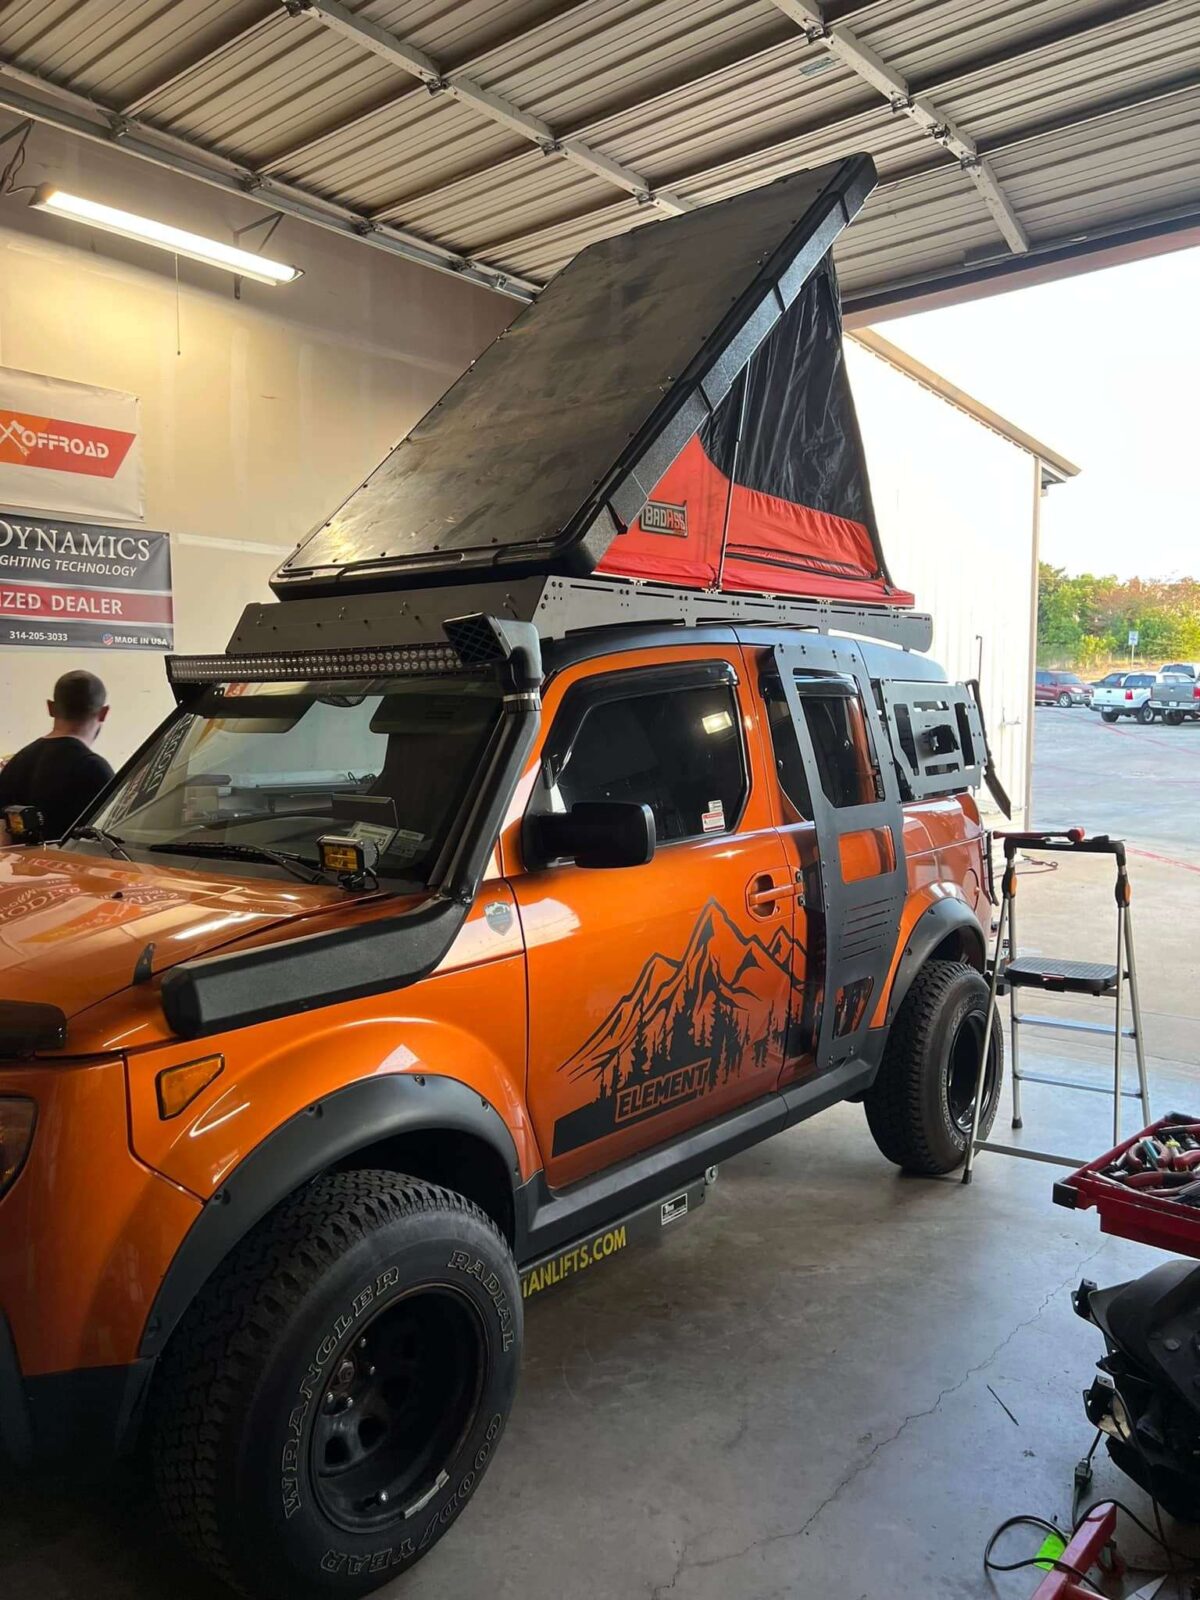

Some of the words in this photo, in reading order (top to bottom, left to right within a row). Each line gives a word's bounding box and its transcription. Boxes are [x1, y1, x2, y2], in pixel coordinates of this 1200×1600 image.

[645, 505, 686, 530] BADASS
[55, 559, 137, 577] TECHNOLOGY
[52, 595, 123, 615] DEALER
[9, 630, 68, 641] 314-205-3033
[114, 635, 138, 645] MADE
[140, 637, 149, 645] IN
[151, 638, 168, 646] USA
[616, 1059, 711, 1121] ELEMENT
[447, 1250, 515, 1352] RADIAL
[282, 1266, 400, 1518] WRANGLER
